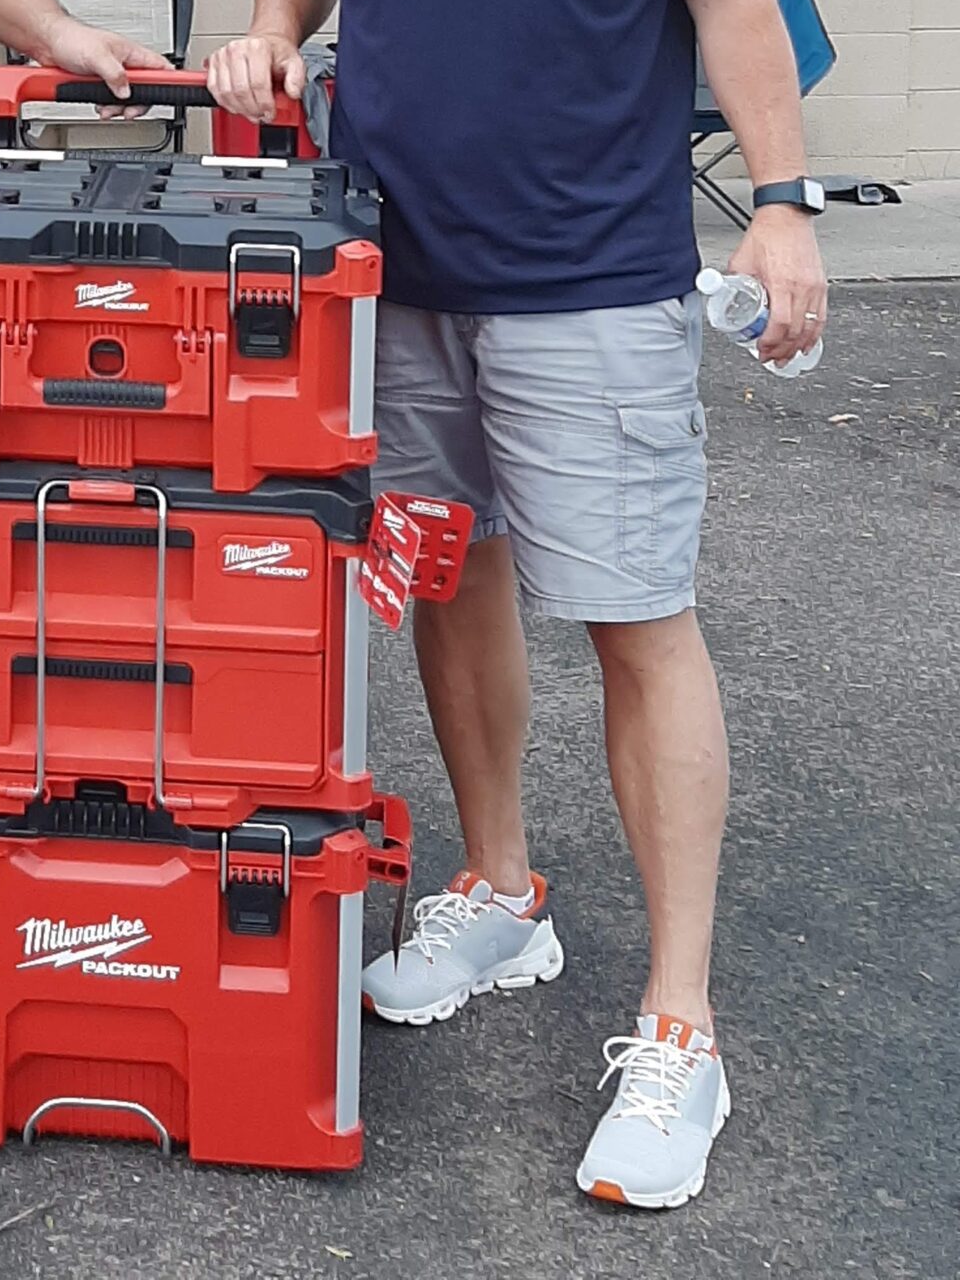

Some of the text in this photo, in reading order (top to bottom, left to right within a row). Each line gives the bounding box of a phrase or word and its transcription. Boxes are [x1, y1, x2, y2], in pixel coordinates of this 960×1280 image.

[222, 541, 291, 566] Milwaukee
[255, 566, 309, 577] PACKOUT
[15, 914, 147, 956] Milwaukee
[82, 960, 180, 980] PACKOUT
